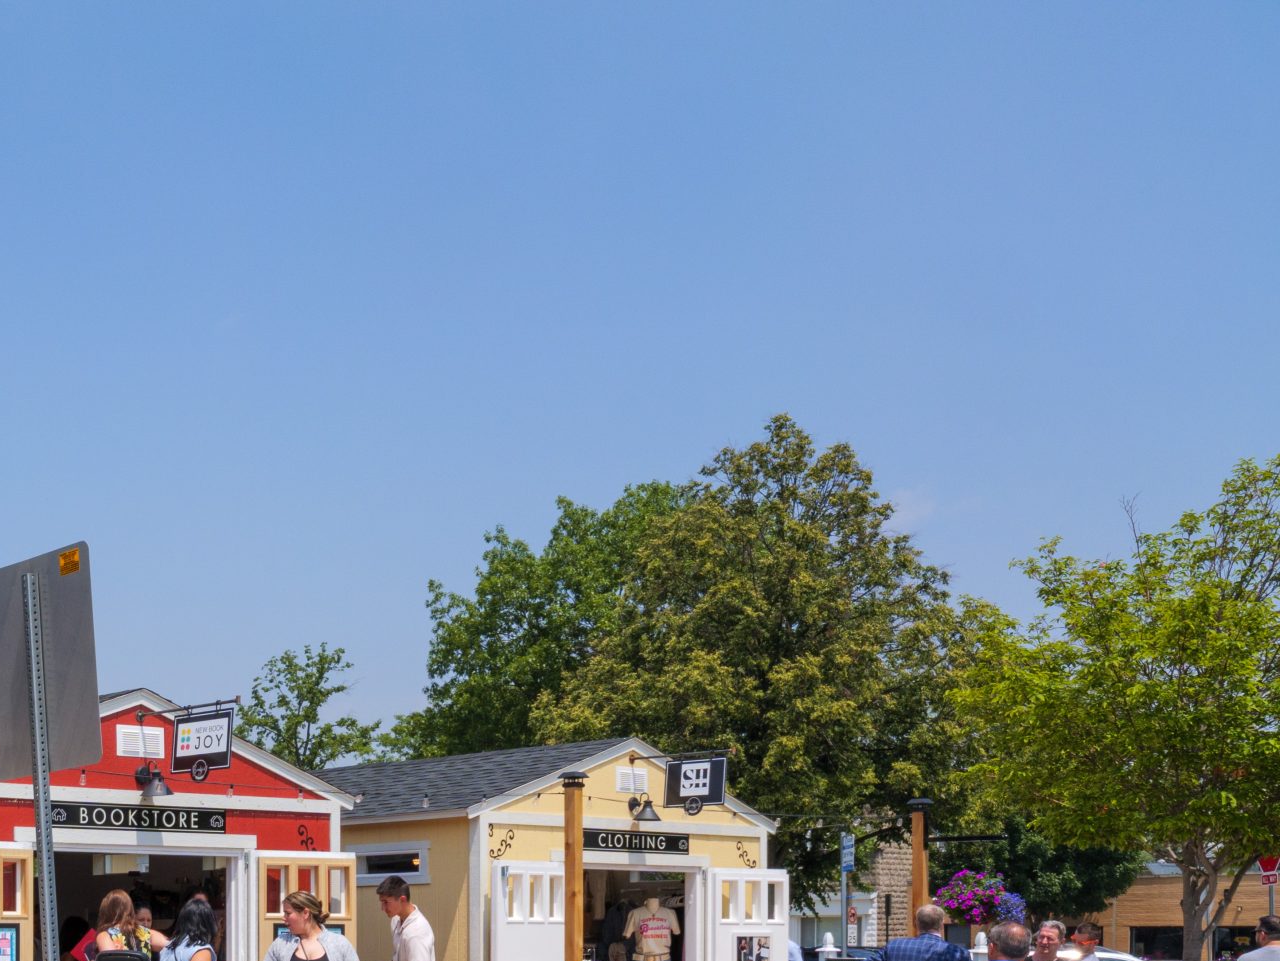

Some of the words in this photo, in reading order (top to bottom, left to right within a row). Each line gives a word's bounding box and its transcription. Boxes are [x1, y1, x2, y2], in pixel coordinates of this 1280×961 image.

[208, 724, 225, 732] BOOK
[194, 733, 224, 750] JOY
[682, 768, 709, 789] SH
[79, 806, 199, 829] BOOKSTORE
[598, 833, 666, 850] CLOTHING
[848, 935, 857, 944] 25
